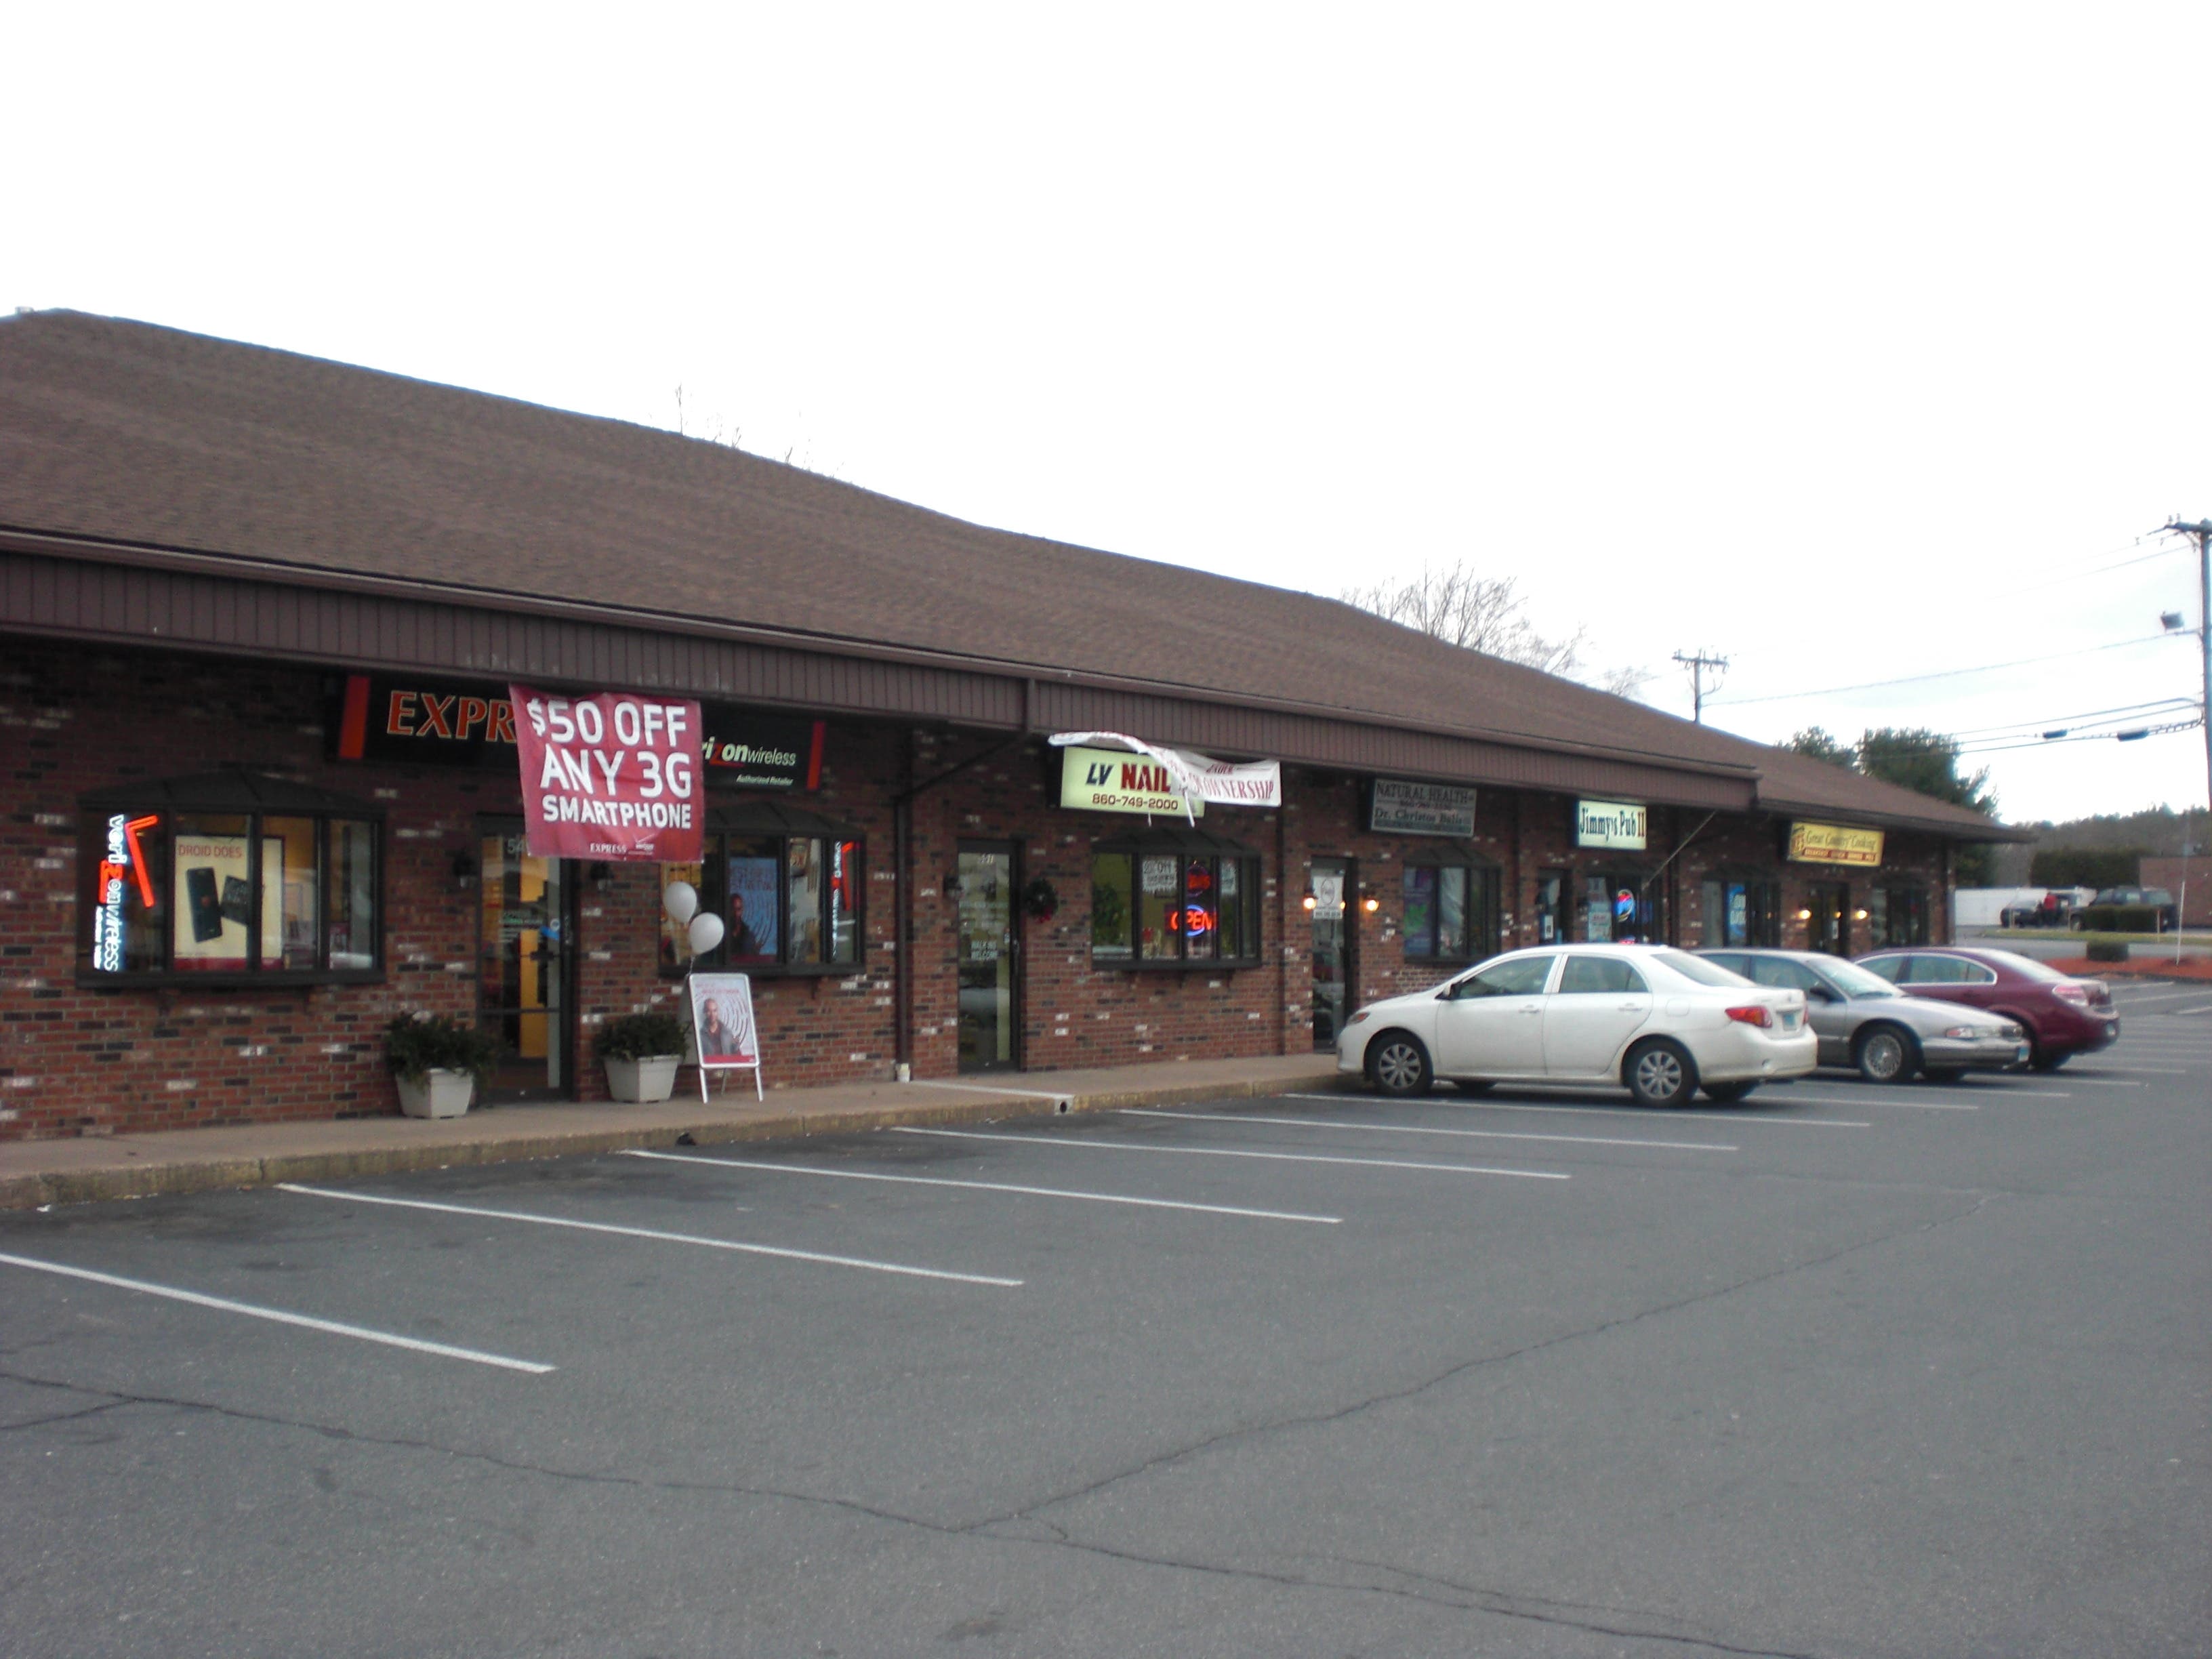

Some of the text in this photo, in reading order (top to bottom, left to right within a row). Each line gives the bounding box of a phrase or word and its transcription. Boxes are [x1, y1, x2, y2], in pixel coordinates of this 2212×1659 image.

[387, 690, 517, 743] EXPR
[527, 697, 686, 747] $50 OFF
[540, 743, 691, 798] ANY 3G
[1086, 762, 1114, 786] LV
[1120, 762, 1171, 794] NAIL
[1092, 793, 1179, 811] 860-749-2000
[1376, 783, 1469, 804] NATURAL HEALTH
[542, 794, 691, 830] SMARTPHONE
[1580, 807, 1617, 842] Jimmy's
[1620, 810, 1636, 836] Pub
[178, 845, 243, 858] DROID DOES
[590, 842, 627, 854] EXPRESS
